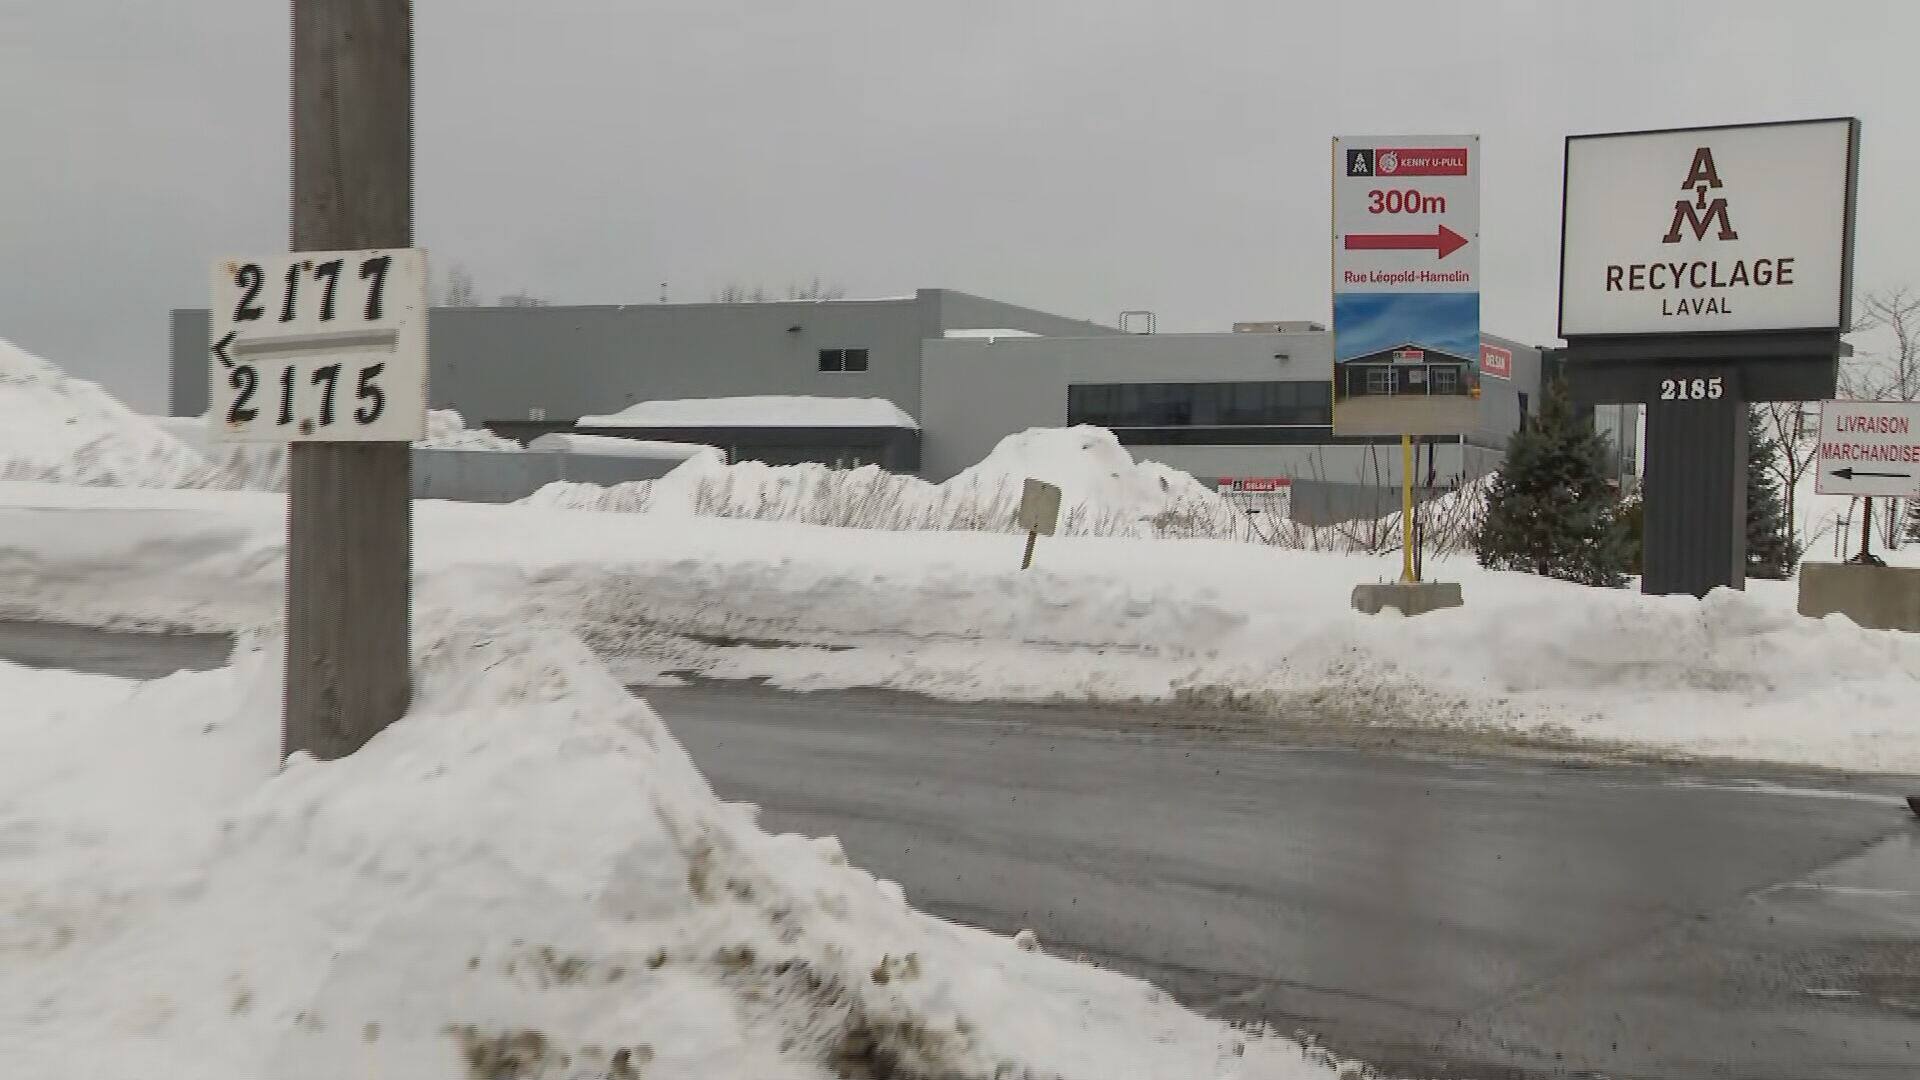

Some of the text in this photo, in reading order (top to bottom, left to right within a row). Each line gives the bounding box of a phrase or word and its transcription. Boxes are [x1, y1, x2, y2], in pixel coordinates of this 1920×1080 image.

[1401, 156, 1464, 167] KENNY U-PULL
[1368, 189, 1446, 214] 300m
[1662, 147, 1738, 243] AIM
[1344, 270, 1470, 285] Rue Léopold-Hamelin
[1606, 258, 1794, 292] RECYCLAGE
[233, 256, 391, 322] 2177
[1662, 297, 1732, 316] LAVAL
[226, 363, 387, 426] 2175
[1660, 377, 1723, 400] 2185
[1836, 415, 1910, 434] LIVRAISON
[1821, 442, 1920, 463] MARCHANDISE
